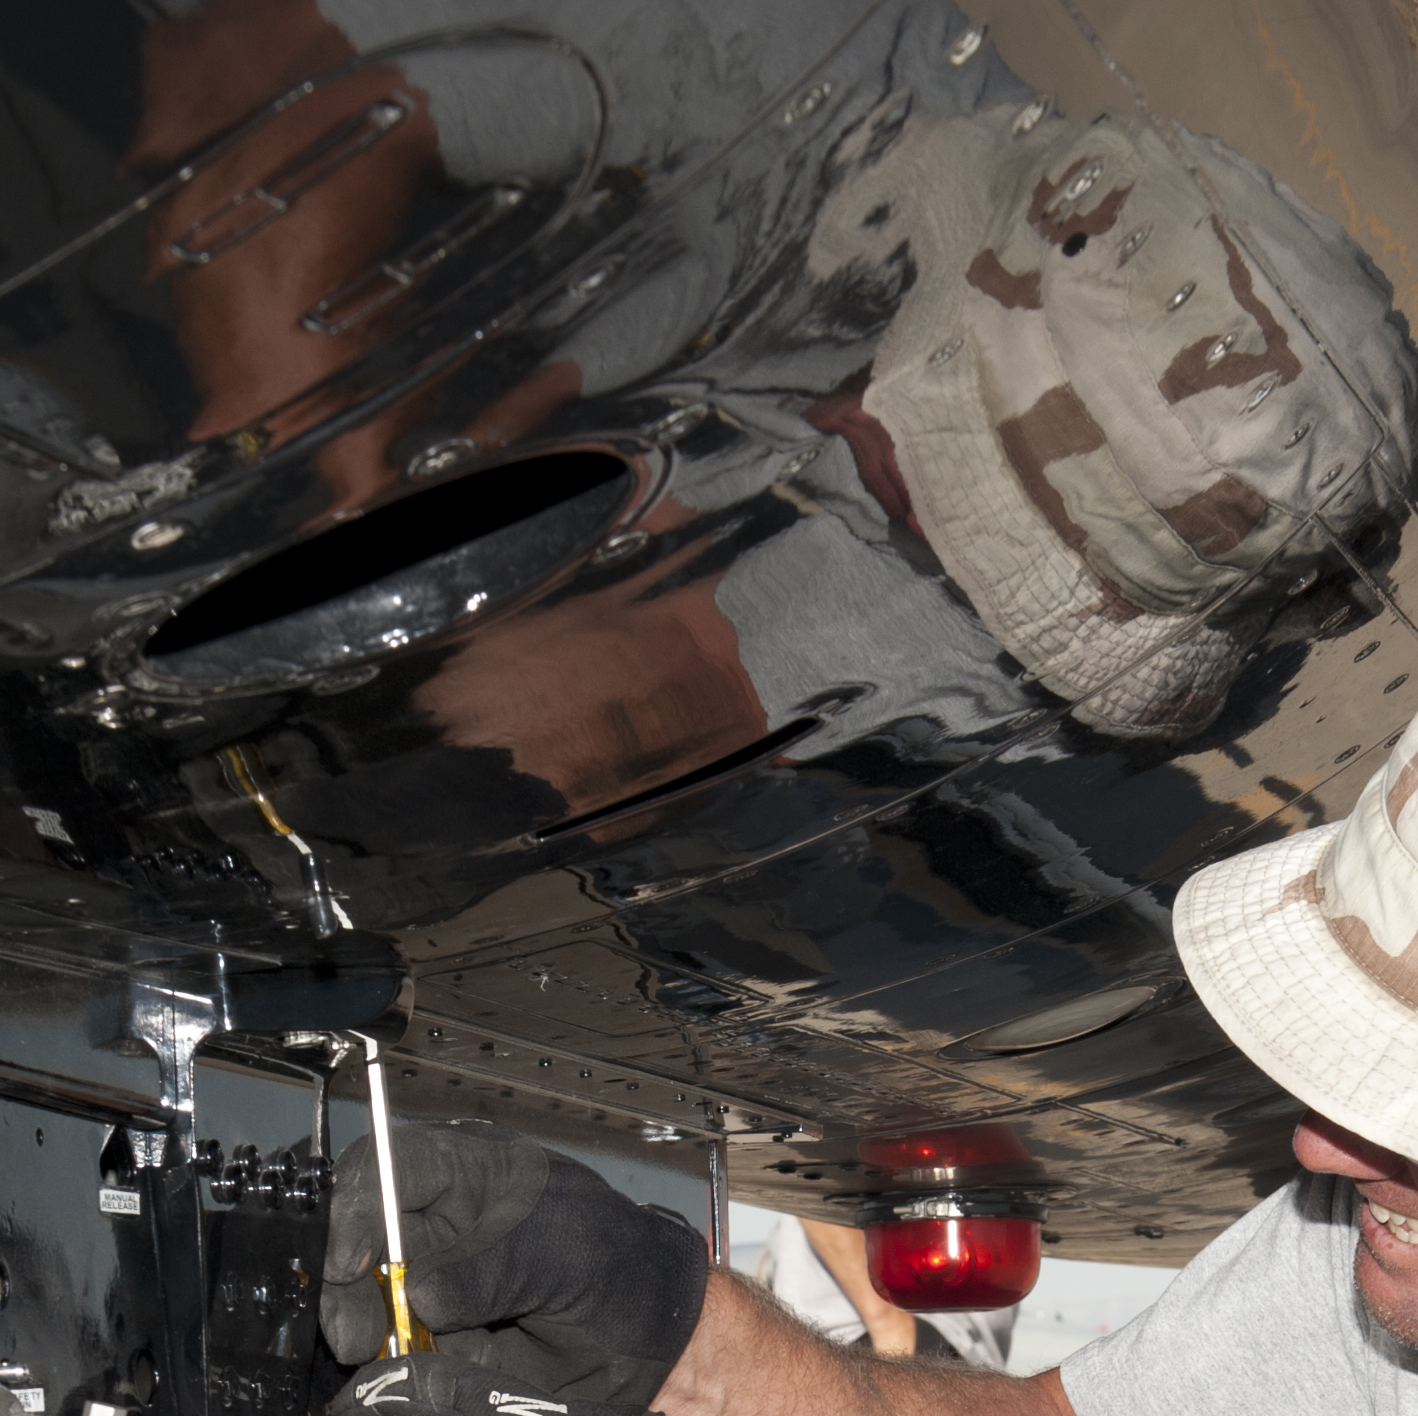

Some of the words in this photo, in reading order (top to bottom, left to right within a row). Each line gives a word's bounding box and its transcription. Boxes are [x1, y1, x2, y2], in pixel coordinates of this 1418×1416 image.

[104, 1193, 136, 1203] MANUAL
[102, 1201, 138, 1210] RELEASE
[18, 1391, 41, 1401] FETY
